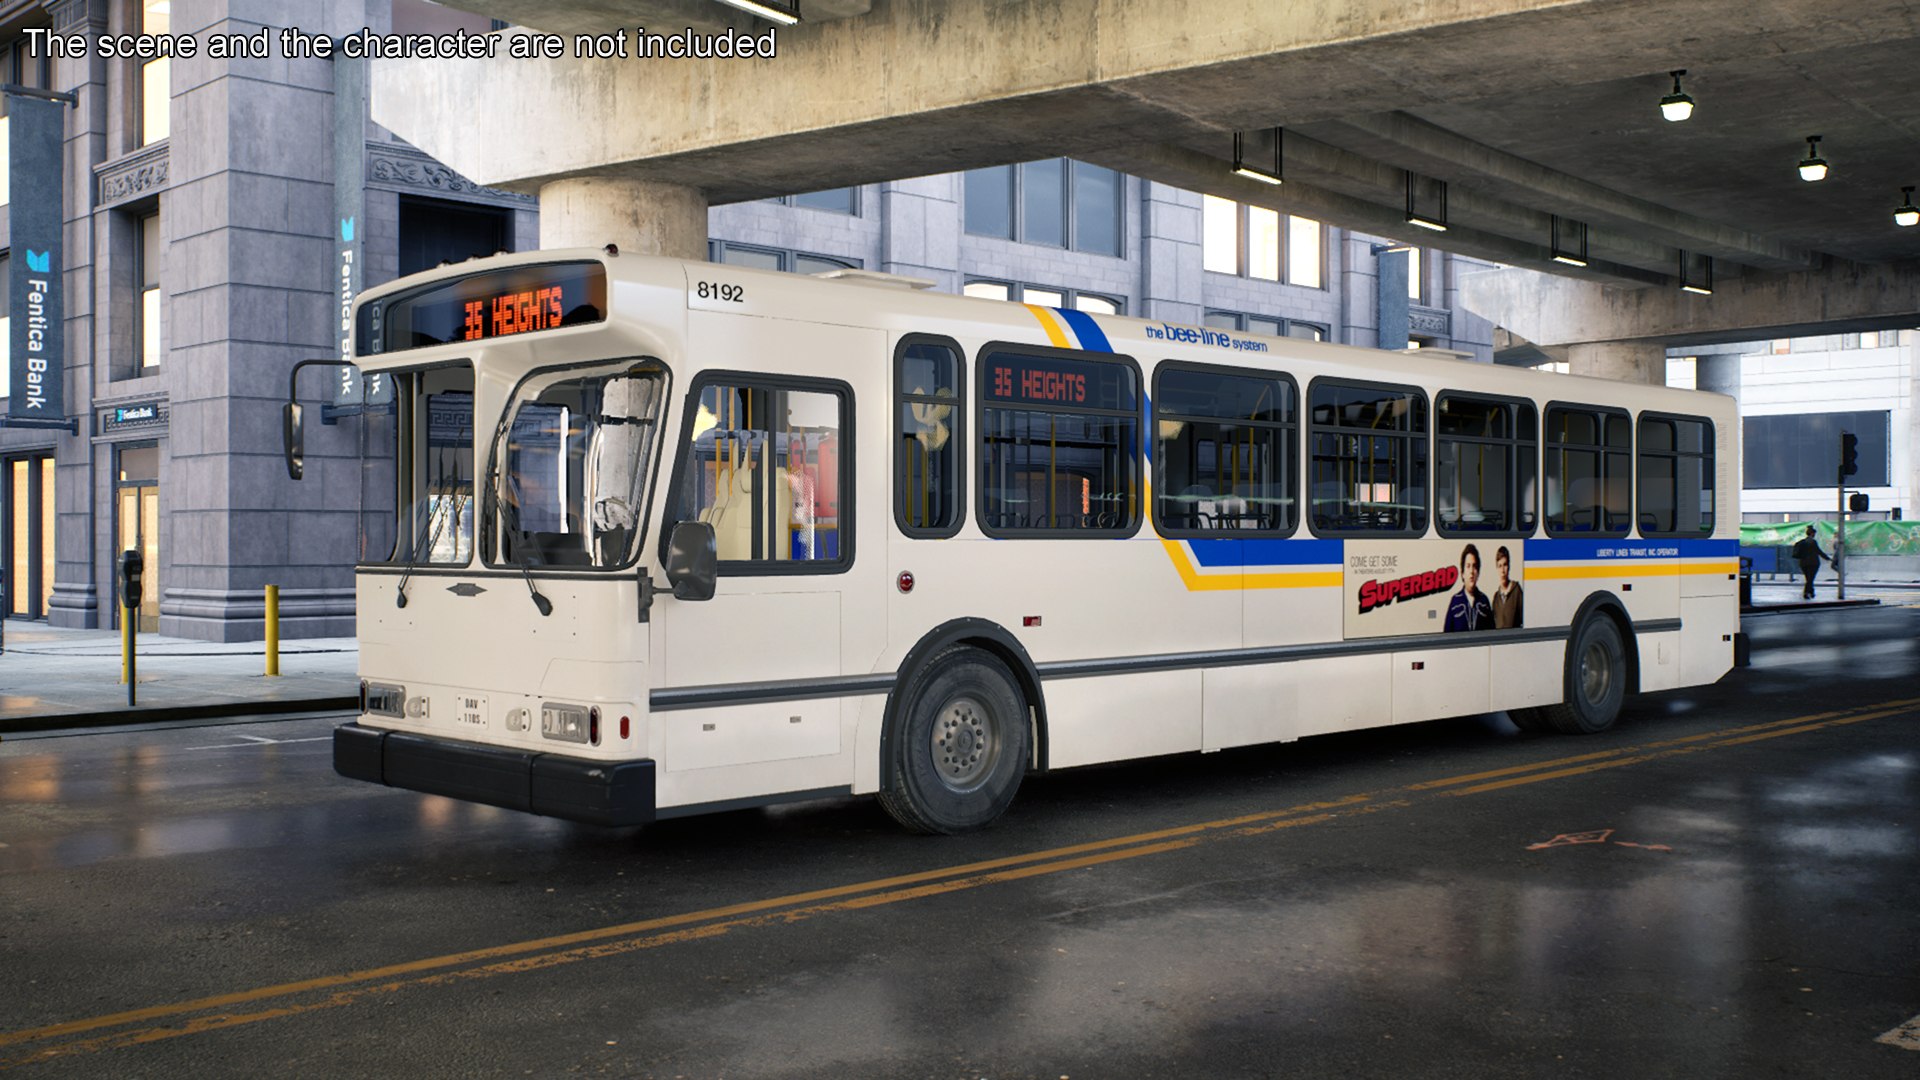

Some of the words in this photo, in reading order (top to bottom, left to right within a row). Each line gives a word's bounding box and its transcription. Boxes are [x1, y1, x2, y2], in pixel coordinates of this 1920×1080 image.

[341, 249, 353, 331] Fentica
[697, 281, 744, 303] 8192
[28, 279, 48, 352] Fentica
[465, 301, 483, 341] 35
[492, 286, 563, 337] HEIGHTS
[1145, 325, 1164, 340] the
[1161, 322, 1231, 348] bee-line
[1232, 338, 1268, 353] system
[26, 358, 47, 409] Bank
[995, 367, 1012, 397] 35
[1021, 369, 1086, 402] HEIGHTS
[139, 407, 153, 418] Bank
[1350, 555, 1368, 568] COME
[1368, 555, 1380, 567] GET
[1381, 555, 1398, 567] SOME
[1358, 565, 1459, 615] SUPERBAD
